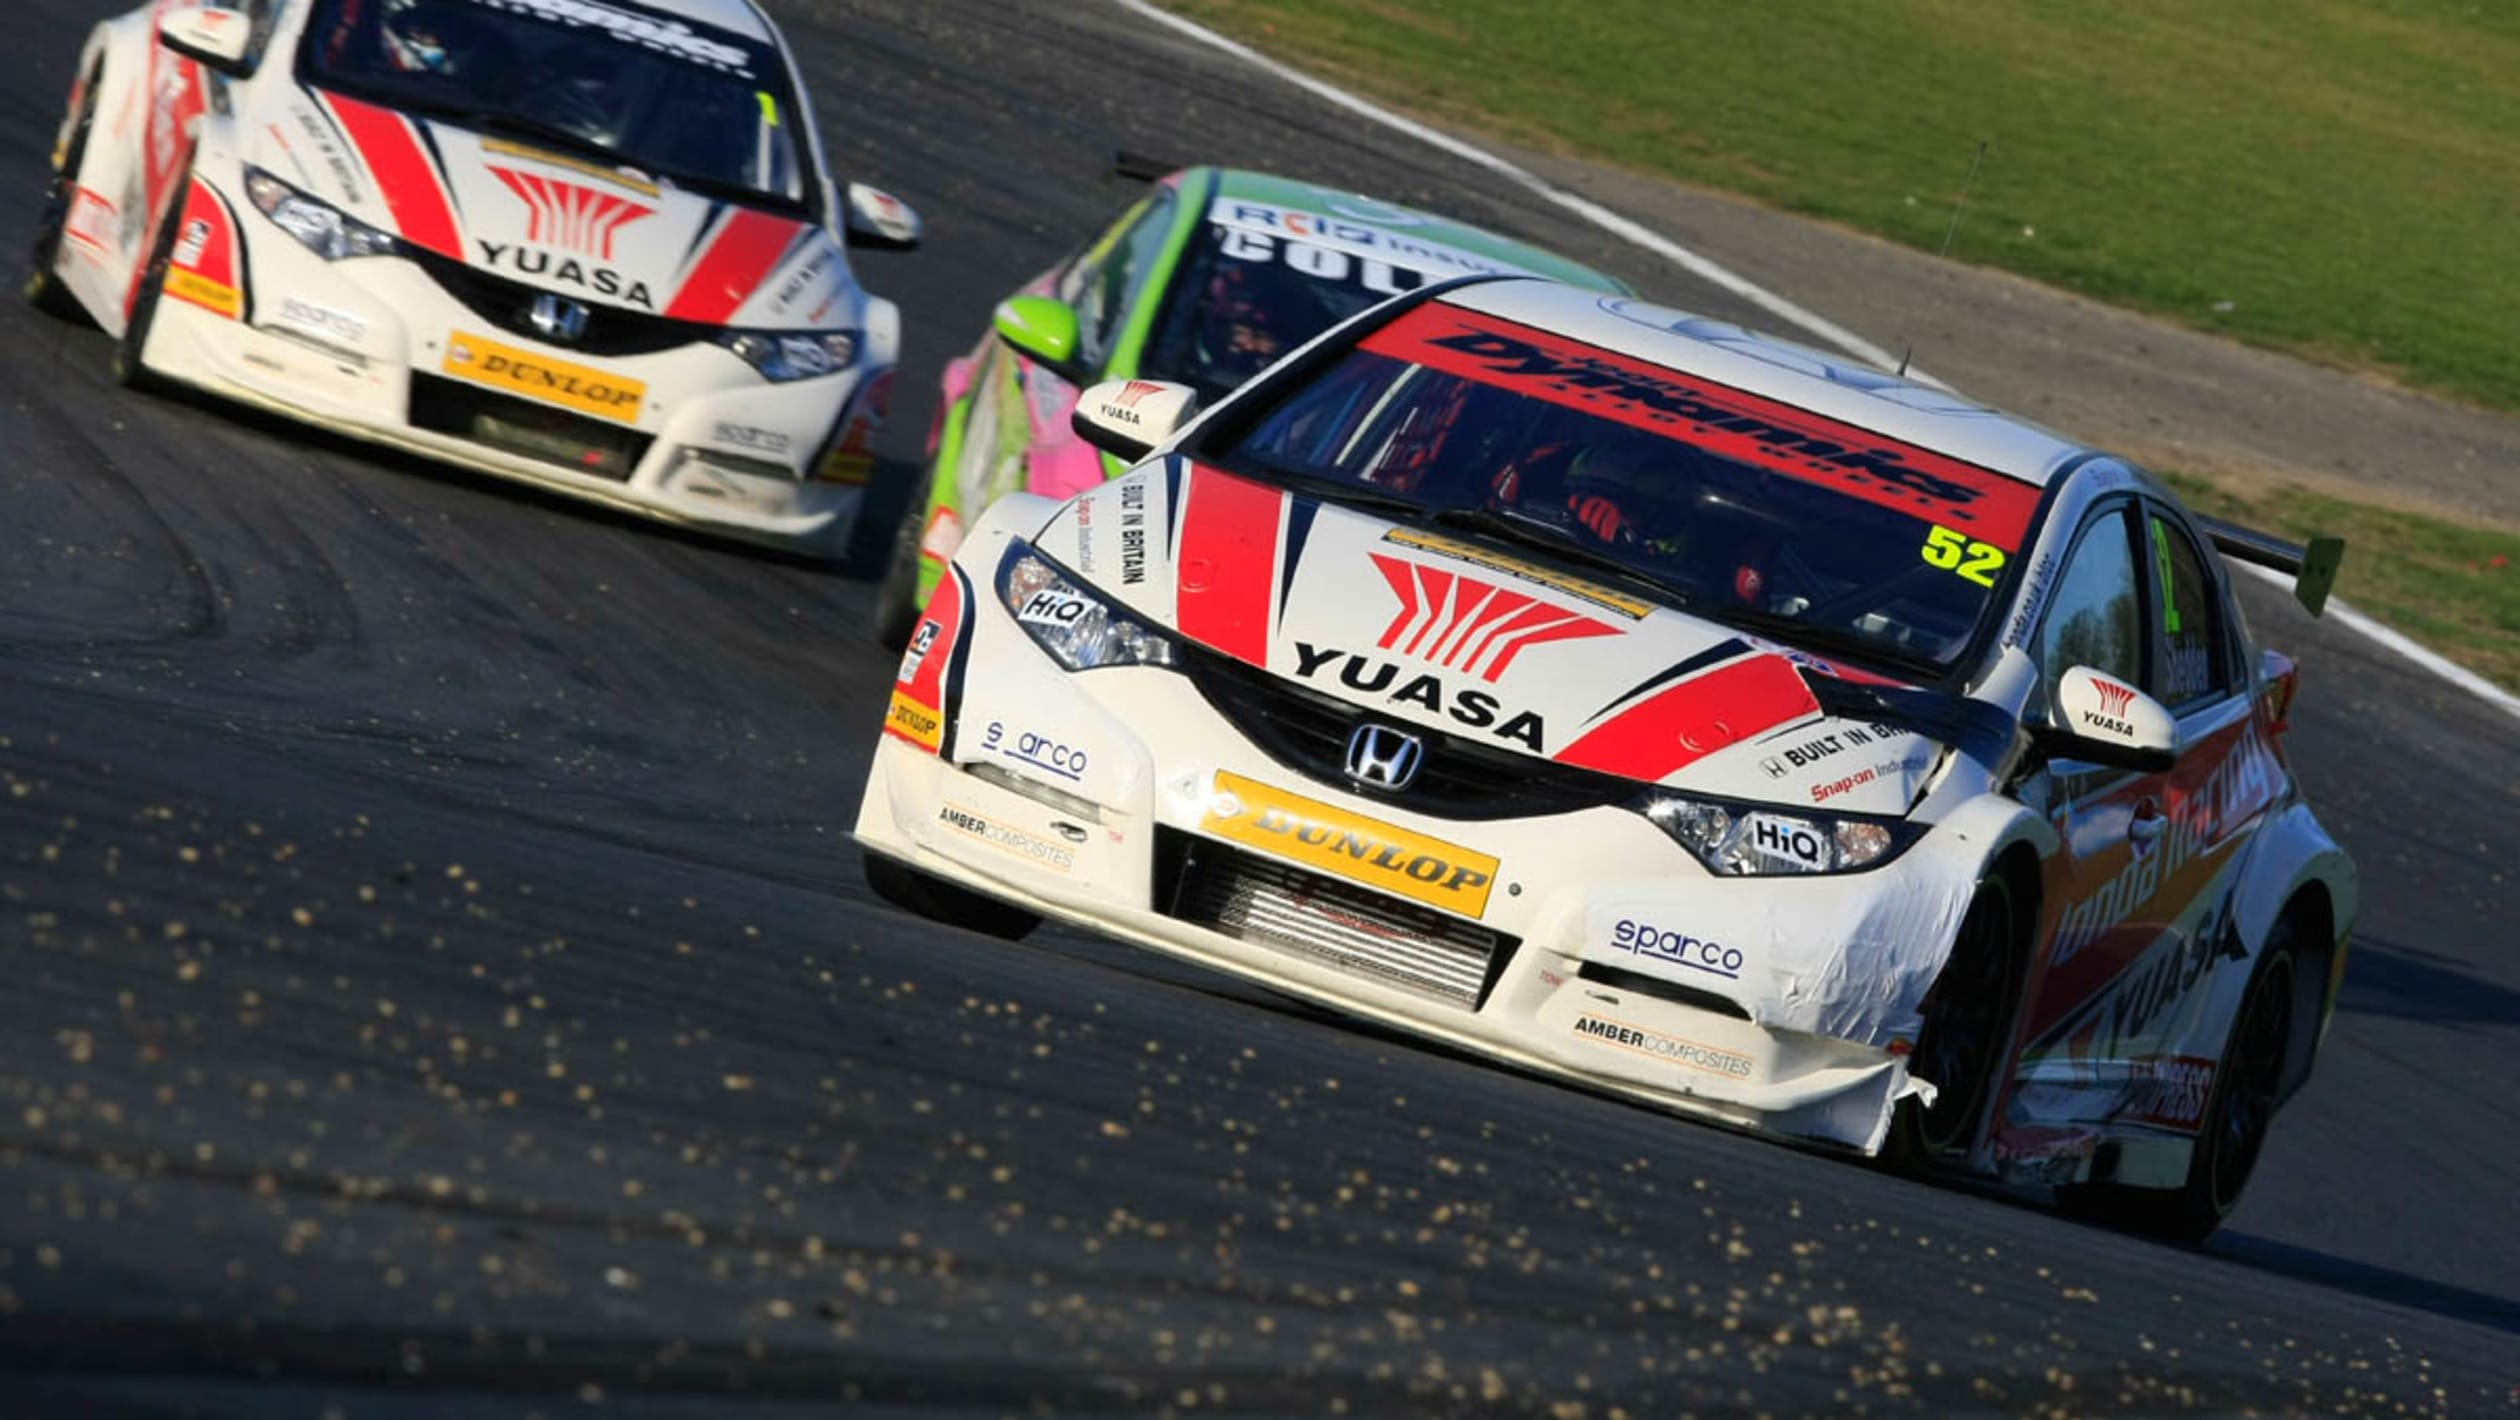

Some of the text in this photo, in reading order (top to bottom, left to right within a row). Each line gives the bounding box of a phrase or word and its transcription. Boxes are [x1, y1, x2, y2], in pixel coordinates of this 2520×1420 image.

[477, 239, 654, 310] YUASA
[482, 353, 640, 408] DUNLOP
[1101, 404, 1141, 425] YUASA
[1921, 524, 2006, 590] 52
[1024, 593, 1084, 622] HiQ
[1294, 641, 1545, 753] YUASA
[2082, 709, 2134, 738] YUASA
[981, 721, 1087, 782] sarco
[1784, 735, 1846, 767] BUILT
[1843, 727, 1873, 747] IN
[1254, 804, 1490, 892] DUNLOP
[1756, 820, 1819, 863] HiQ
[1610, 918, 1744, 980] sparco
